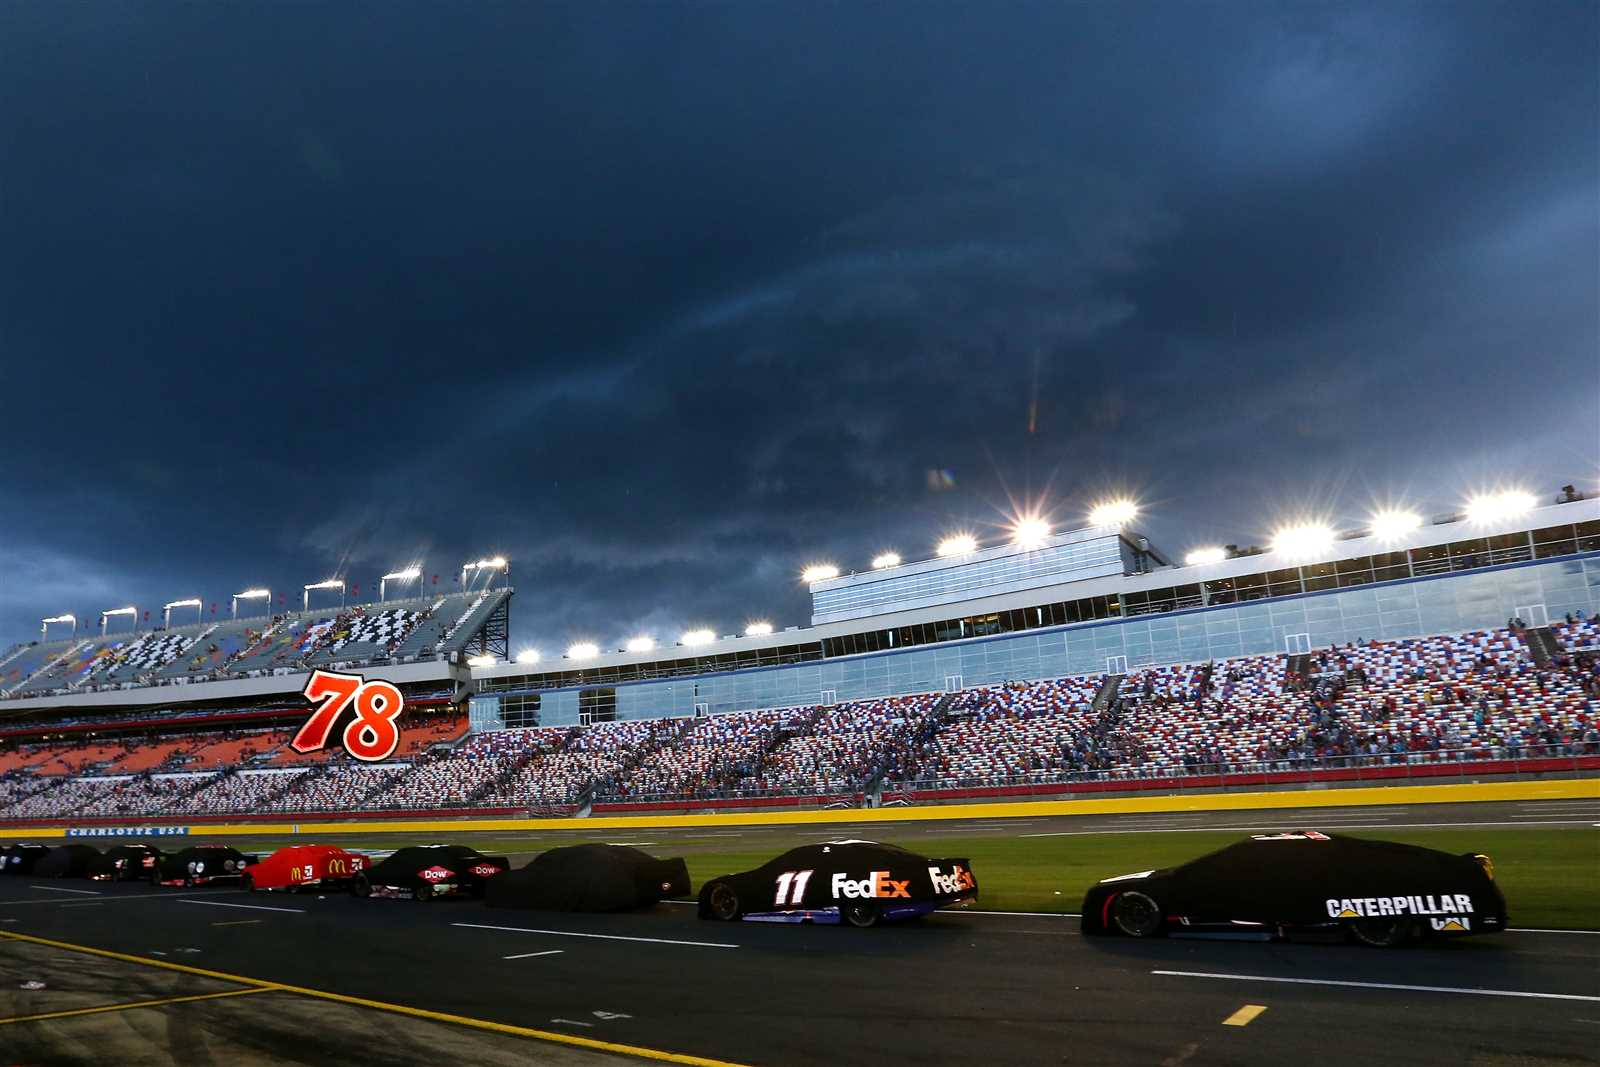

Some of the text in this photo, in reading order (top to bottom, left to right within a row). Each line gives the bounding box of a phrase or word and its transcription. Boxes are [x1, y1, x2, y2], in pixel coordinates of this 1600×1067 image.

[70, 826, 185, 836] CHARLOTTE USA
[774, 869, 815, 907] 11
[831, 871, 912, 900] FedEx
[927, 864, 976, 895] FedEx
[1326, 893, 1474, 918] CATERPILLAR
